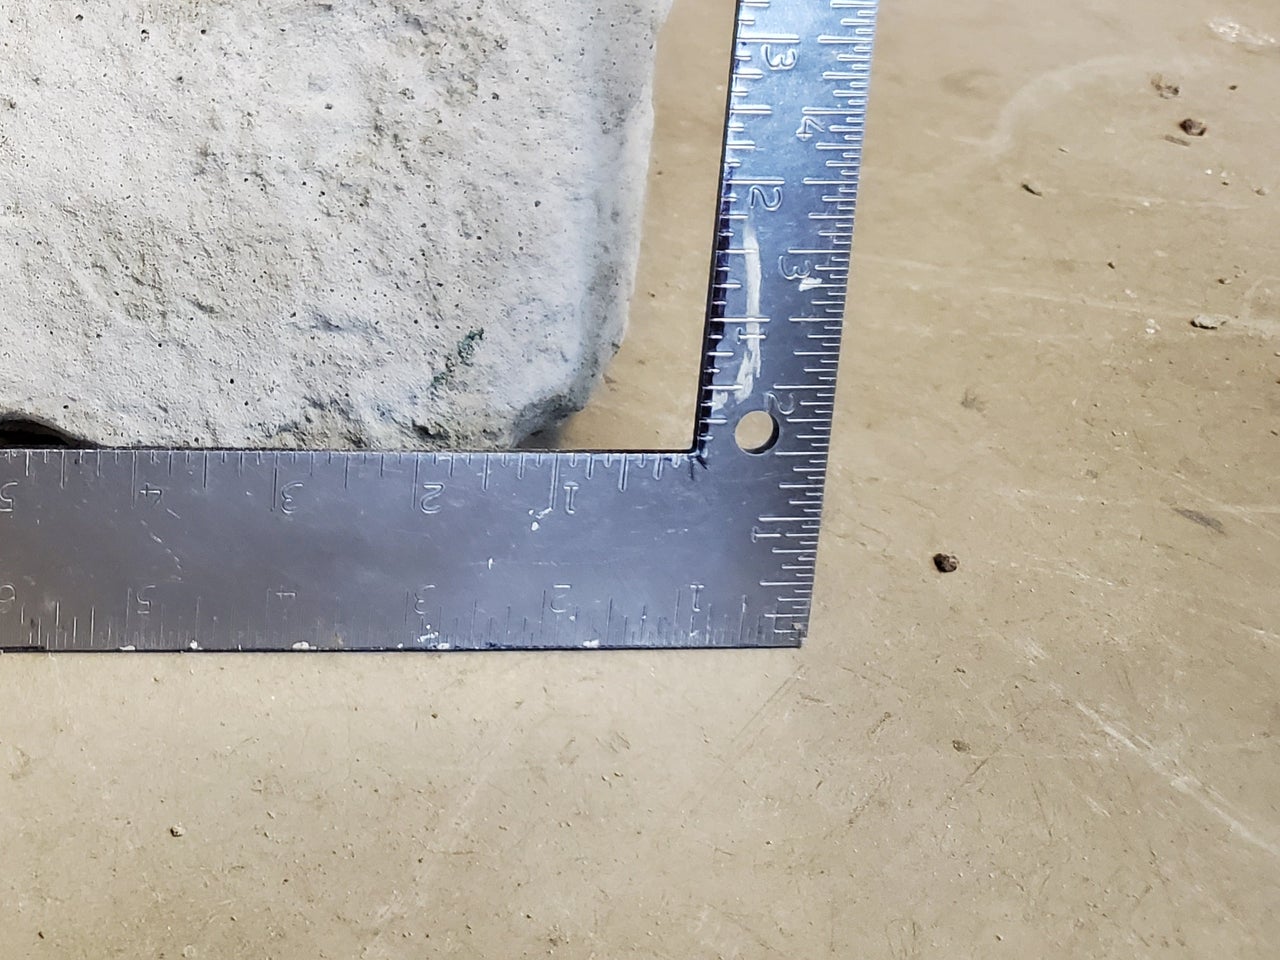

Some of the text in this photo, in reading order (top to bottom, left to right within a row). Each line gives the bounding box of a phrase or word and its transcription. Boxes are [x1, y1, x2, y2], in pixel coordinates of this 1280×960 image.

[761, 44, 797, 70] 3
[749, 186, 784, 211] 2
[279, 481, 304, 514] 3
[420, 481, 446, 514] 2
[135, 584, 158, 615] 5
